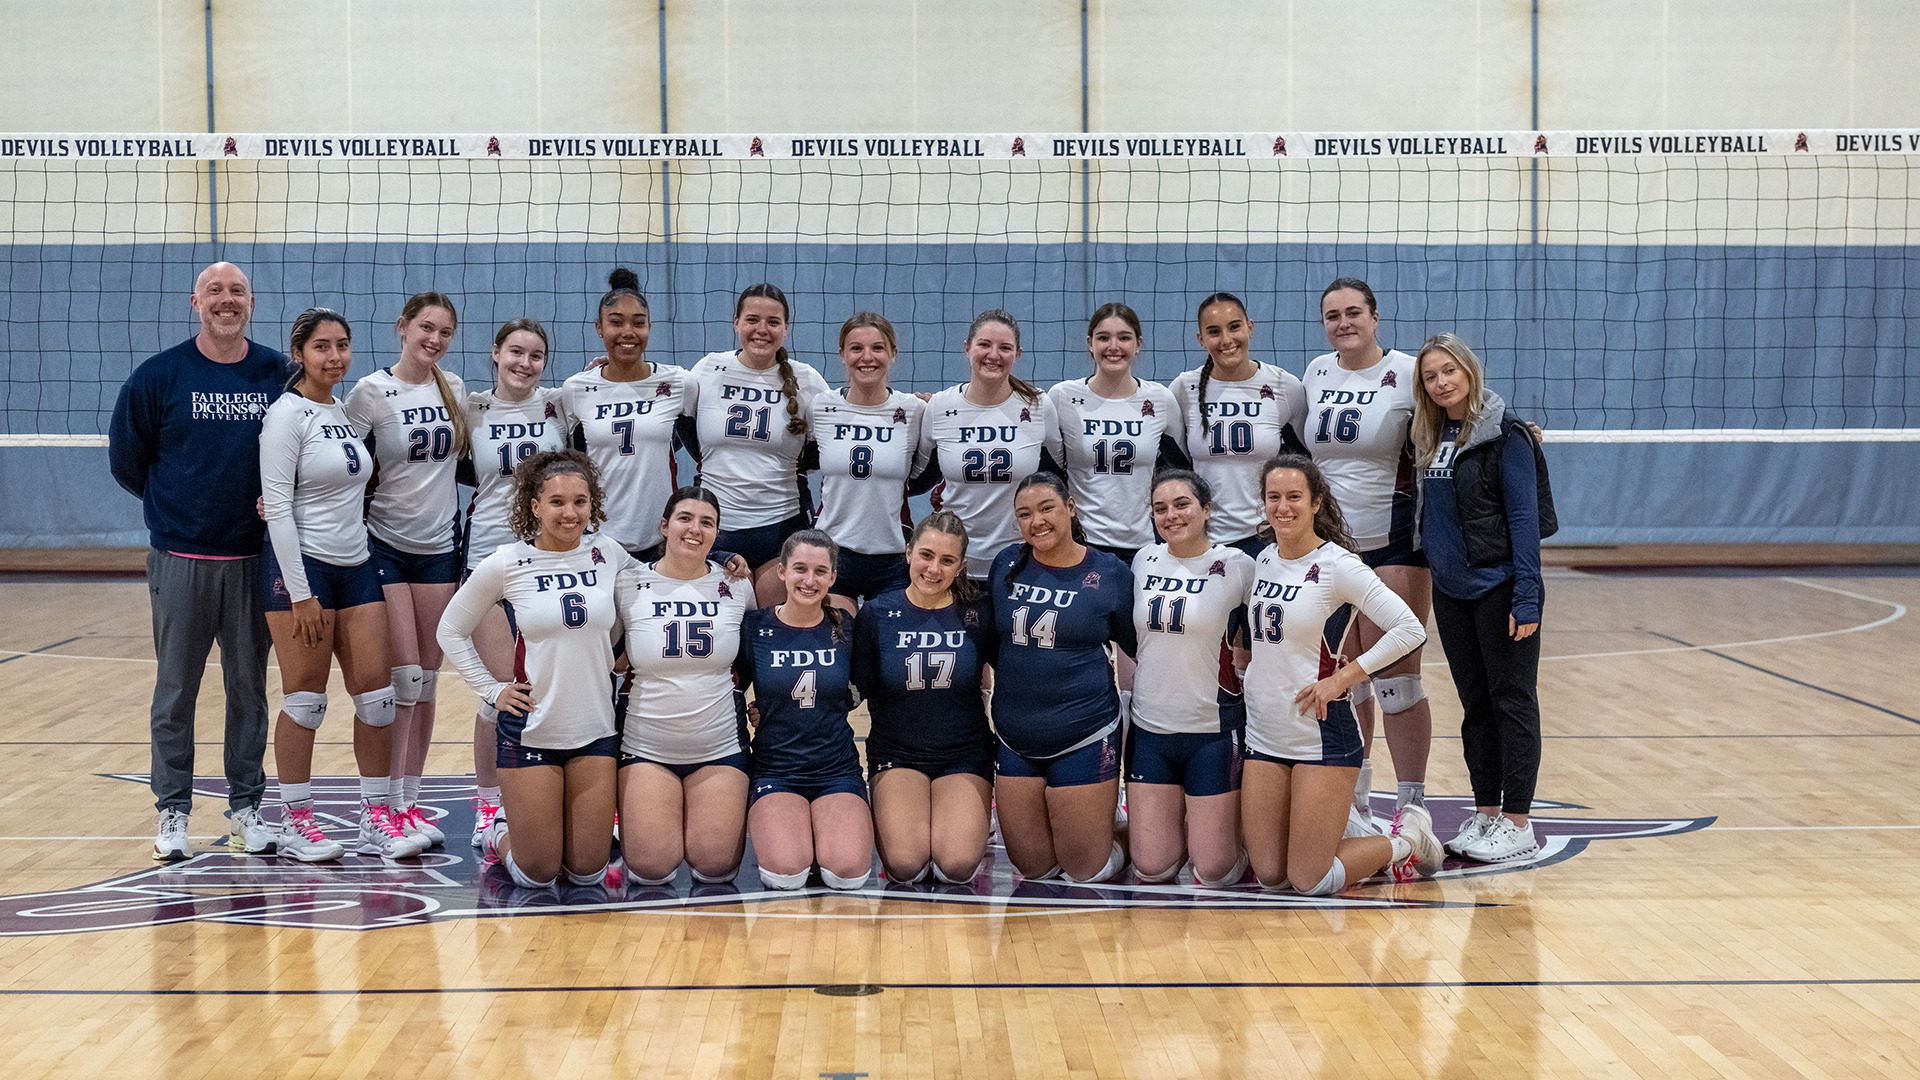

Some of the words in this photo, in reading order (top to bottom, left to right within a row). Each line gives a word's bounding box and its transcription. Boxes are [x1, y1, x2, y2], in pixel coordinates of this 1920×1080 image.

[1, 139, 68, 156] DEVILS
[75, 139, 196, 156] VOLLEYBALL
[265, 139, 332, 156] DEVILS
[339, 139, 459, 157] VOLLEYBALL
[528, 139, 596, 156] DEVILS
[602, 139, 722, 157] VOLLEYBALL
[791, 139, 859, 156] DEVILS
[865, 139, 984, 156] VOLLEYBALL
[1052, 139, 1120, 156] DEVILS
[1126, 139, 1245, 156] VOLLEYBALL
[1314, 138, 1381, 155] DEVILS
[1387, 138, 1506, 155] VOLLEYBALL
[1576, 137, 1641, 154] DEVILS
[1649, 137, 1767, 154] VOLLEYBALL
[1835, 134, 1902, 152] DEVILS
[191, 392, 269, 405] FAIRLEIGH
[721, 384, 783, 404] FDU
[1317, 389, 1378, 405] FDU
[192, 413, 263, 421] UNIVERSIT
[401, 405, 451, 425] FDU
[595, 400, 654, 421] FDU
[1201, 401, 1262, 417] FDU
[321, 424, 359, 439] FDU
[489, 422, 546, 440] FDU
[725, 403, 772, 442] 21
[1082, 419, 1143, 436] FDU
[1315, 407, 1362, 444] 16
[612, 419, 635, 457] 7
[833, 424, 894, 443] FDU
[958, 426, 1017, 443] FDU
[1209, 420, 1254, 456] 10
[407, 425, 454, 463] 20
[341, 441, 362, 477] 9
[849, 444, 874, 480] 8
[962, 447, 1013, 484] 22
[1093, 438, 1137, 475] 12
[534, 569, 599, 592] FDU
[1143, 574, 1208, 594] FDU
[1252, 579, 1303, 602] FDU
[1008, 582, 1078, 608] FDU
[560, 591, 588, 630] 6
[652, 601, 720, 618] FDU
[1146, 594, 1188, 635] 11
[1011, 605, 1059, 649] 14
[1252, 600, 1286, 645] 13
[662, 620, 715, 659] 15
[896, 630, 966, 649] FDU
[770, 648, 837, 668] FDU
[905, 652, 957, 690] 17
[791, 669, 818, 709] 4
